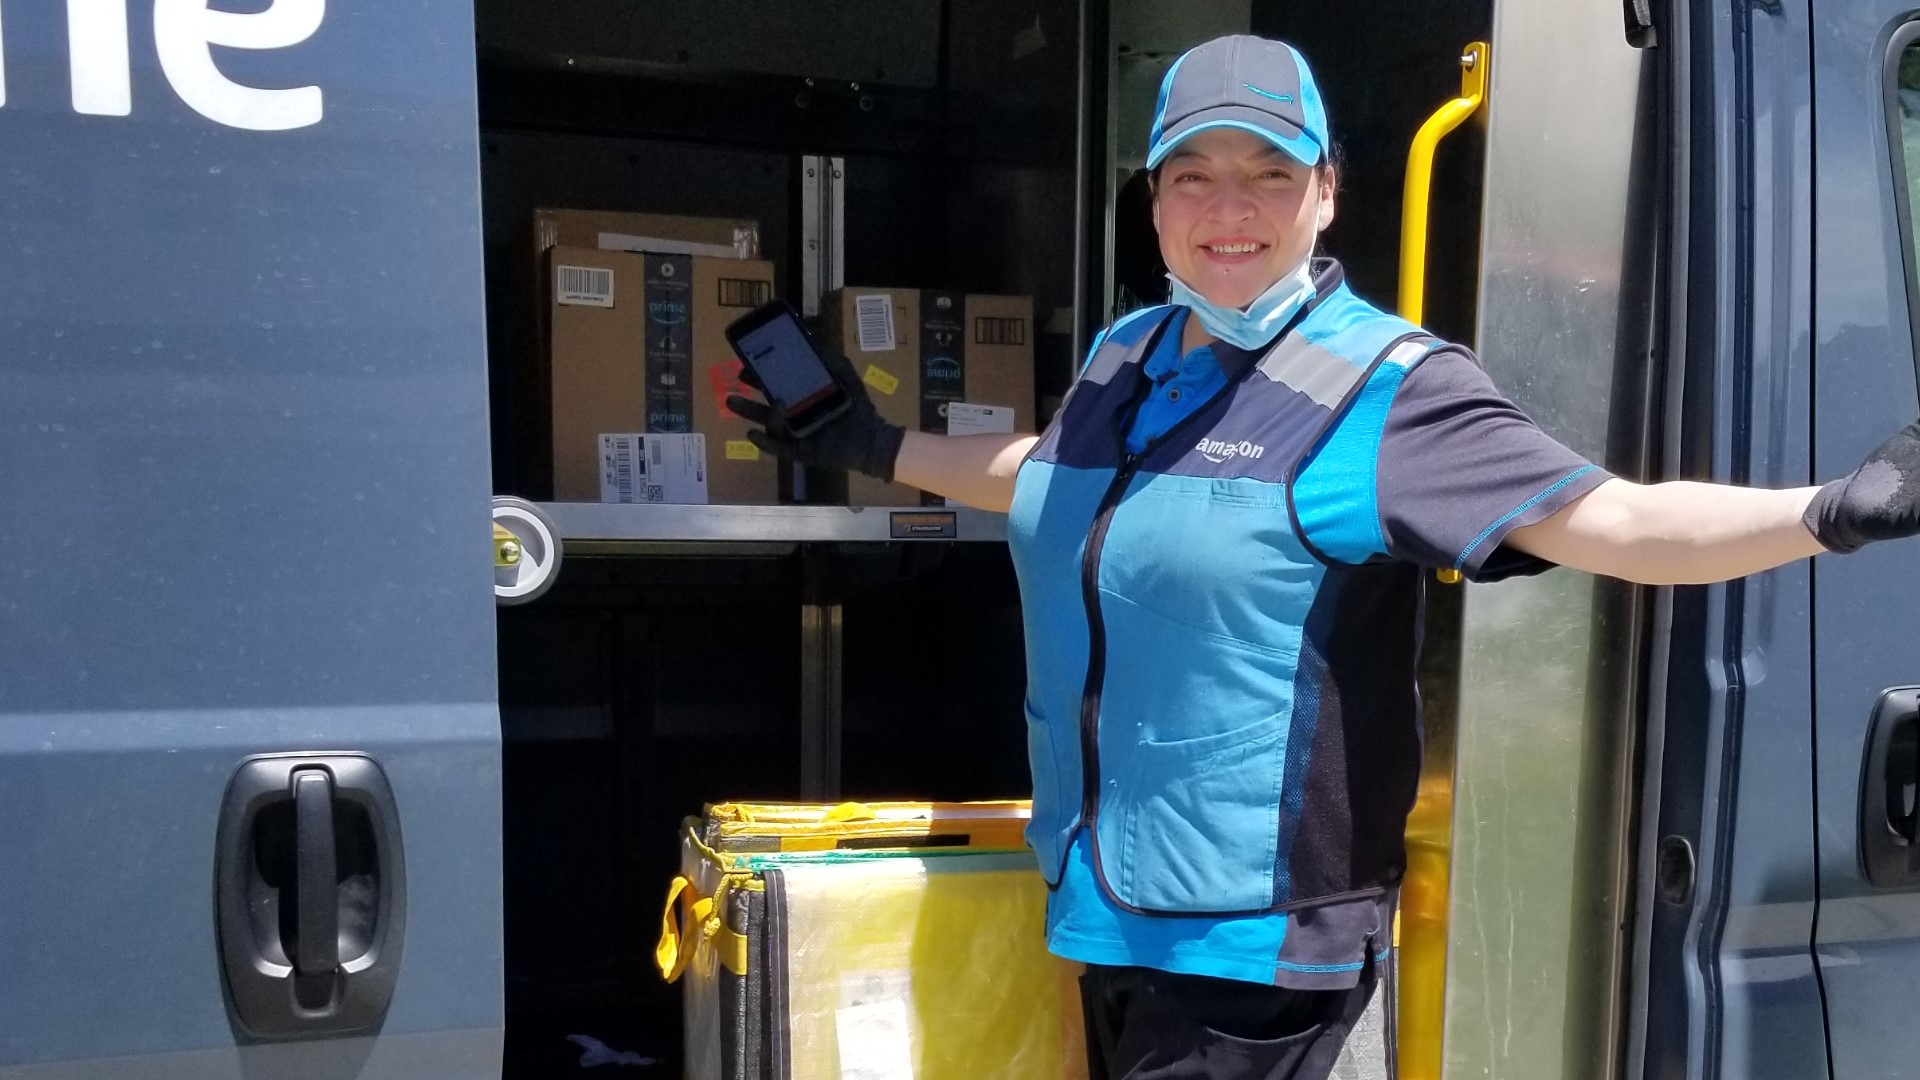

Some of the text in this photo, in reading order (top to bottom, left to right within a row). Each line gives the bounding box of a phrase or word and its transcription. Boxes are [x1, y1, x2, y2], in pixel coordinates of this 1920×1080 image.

[649, 302, 686, 314] prime
[926, 368, 961, 381] prime
[650, 411, 686, 424] prime
[1195, 437, 1265, 460] amazon
